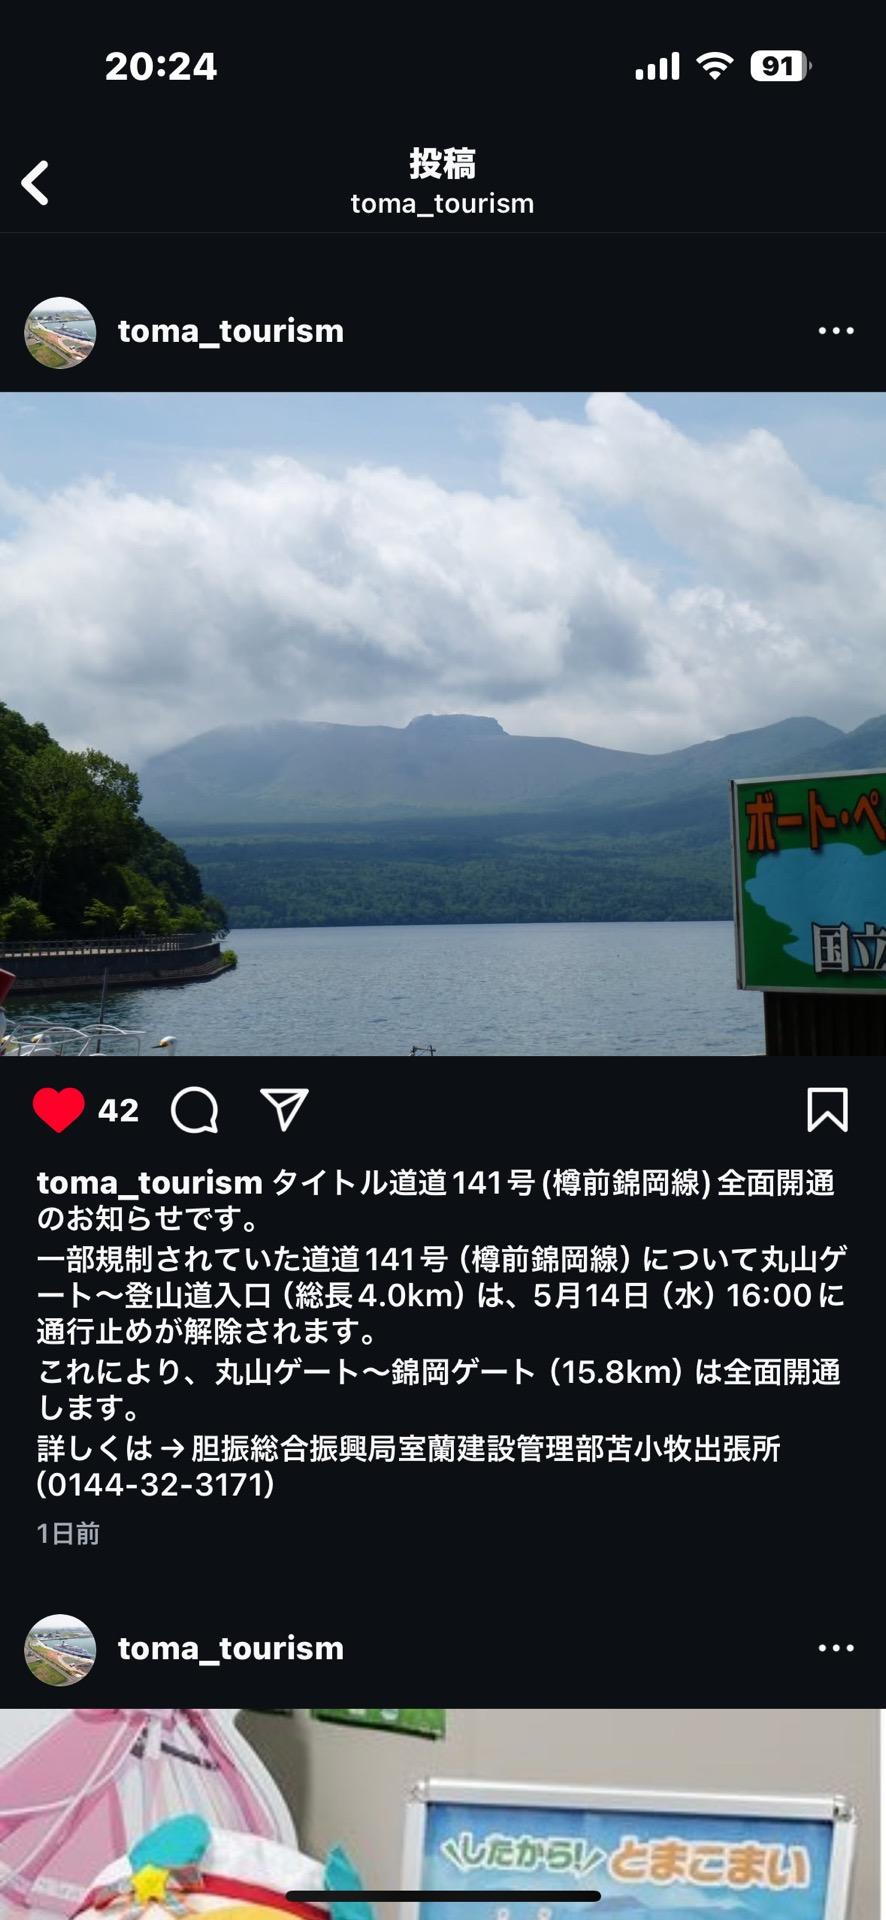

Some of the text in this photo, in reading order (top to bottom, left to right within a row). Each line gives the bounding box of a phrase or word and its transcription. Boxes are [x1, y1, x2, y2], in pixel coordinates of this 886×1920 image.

[105, 51, 218, 81] 20:24
[762, 55, 793, 77] 91
[409, 146, 476, 180] 投稿
[350, 191, 534, 218] toma_tourism
[117, 316, 344, 350] toma_tourism
[98, 1098, 139, 1123] 42
[36, 1167, 264, 1201] toma_tourism
[37, 1204, 255, 1233] のお知らせです。
[36, 1316, 373, 1346] 通行止めが解除されます。
[41, 1394, 136, 1422] します。
[36, 1469, 274, 1499] (0144-32-3171)
[37, 1521, 100, 1546] 1日前
[117, 1633, 344, 1667] toma_tourism
[608, 1839, 809, 1888] とまこまい
